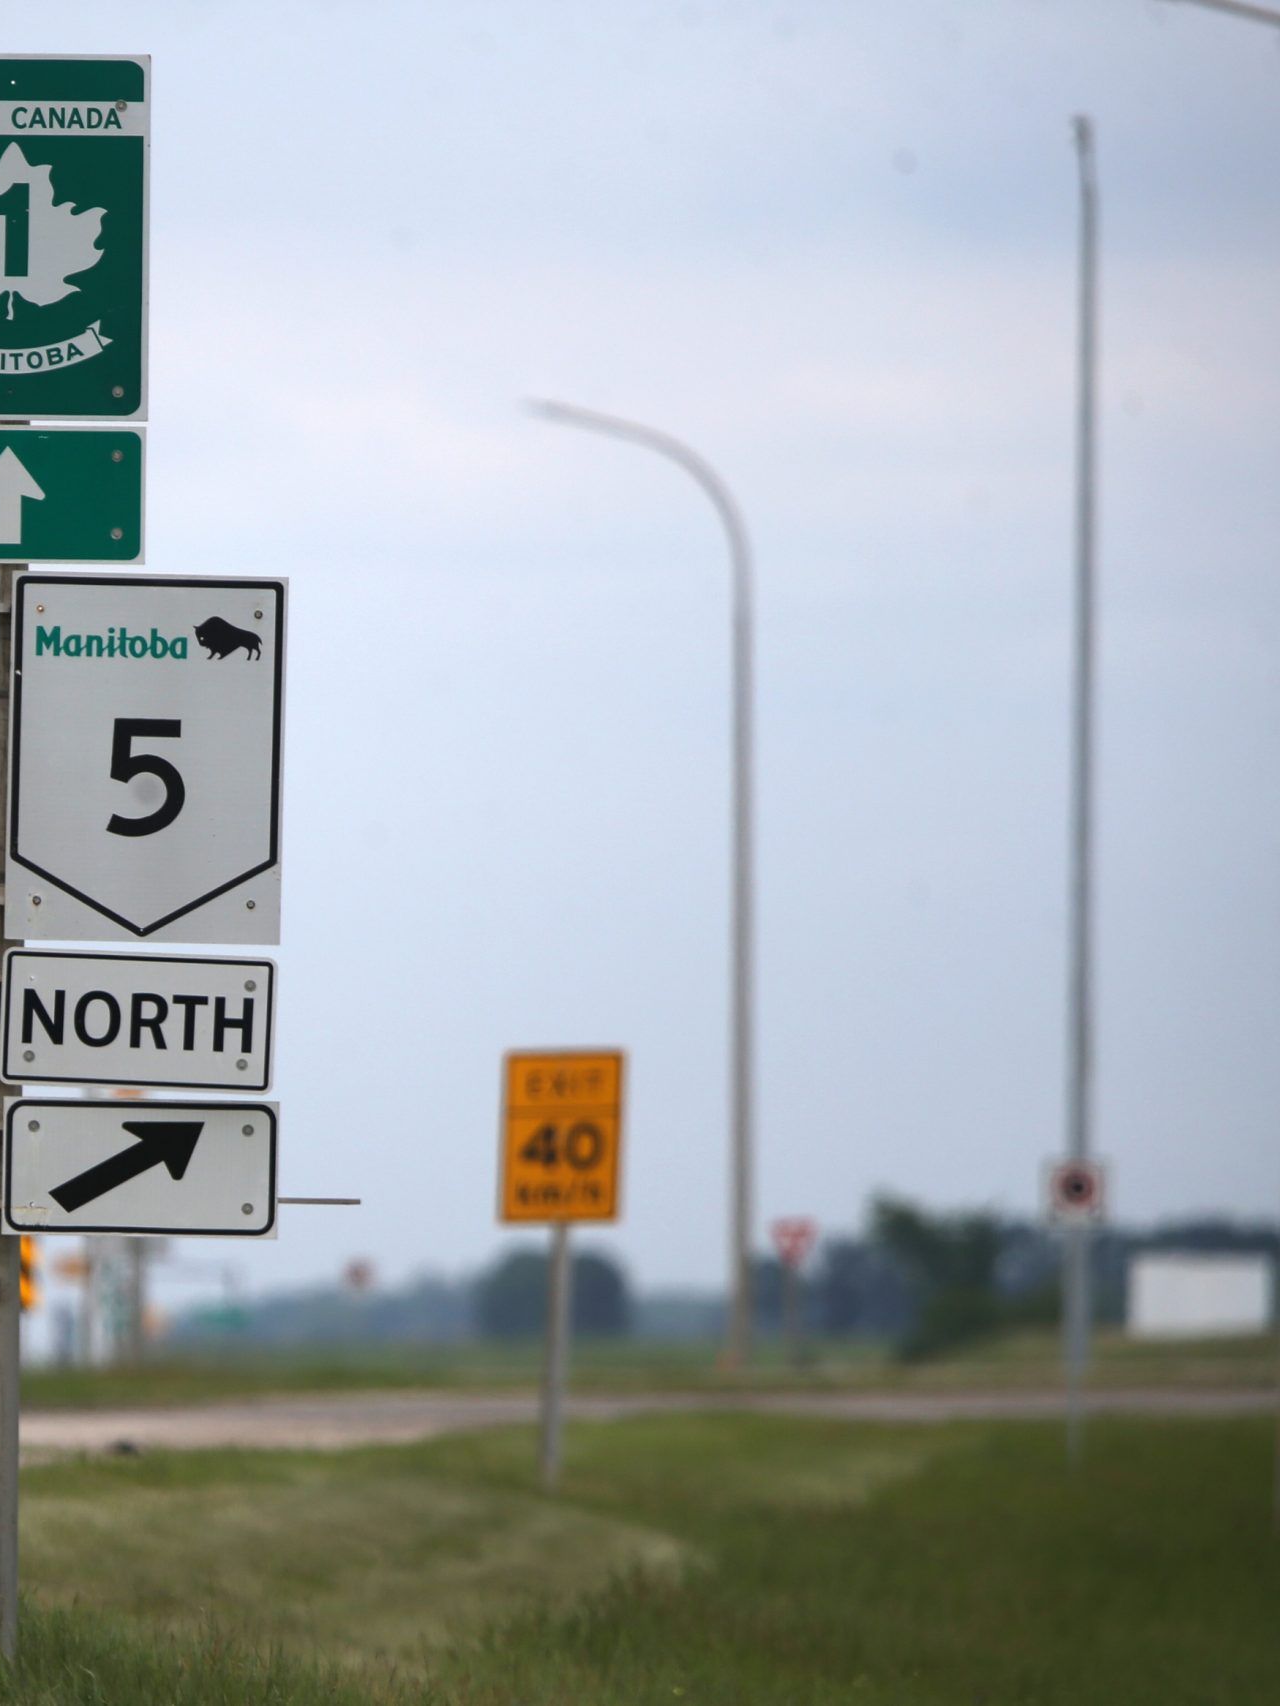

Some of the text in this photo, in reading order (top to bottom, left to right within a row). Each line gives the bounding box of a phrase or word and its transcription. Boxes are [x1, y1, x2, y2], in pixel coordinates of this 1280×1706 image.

[11, 107, 122, 130] CANADA
[35, 625, 188, 660] Manitoba
[106, 717, 185, 837] 5
[21, 988, 255, 1053] NORTH
[520, 1120, 607, 1172] 40
